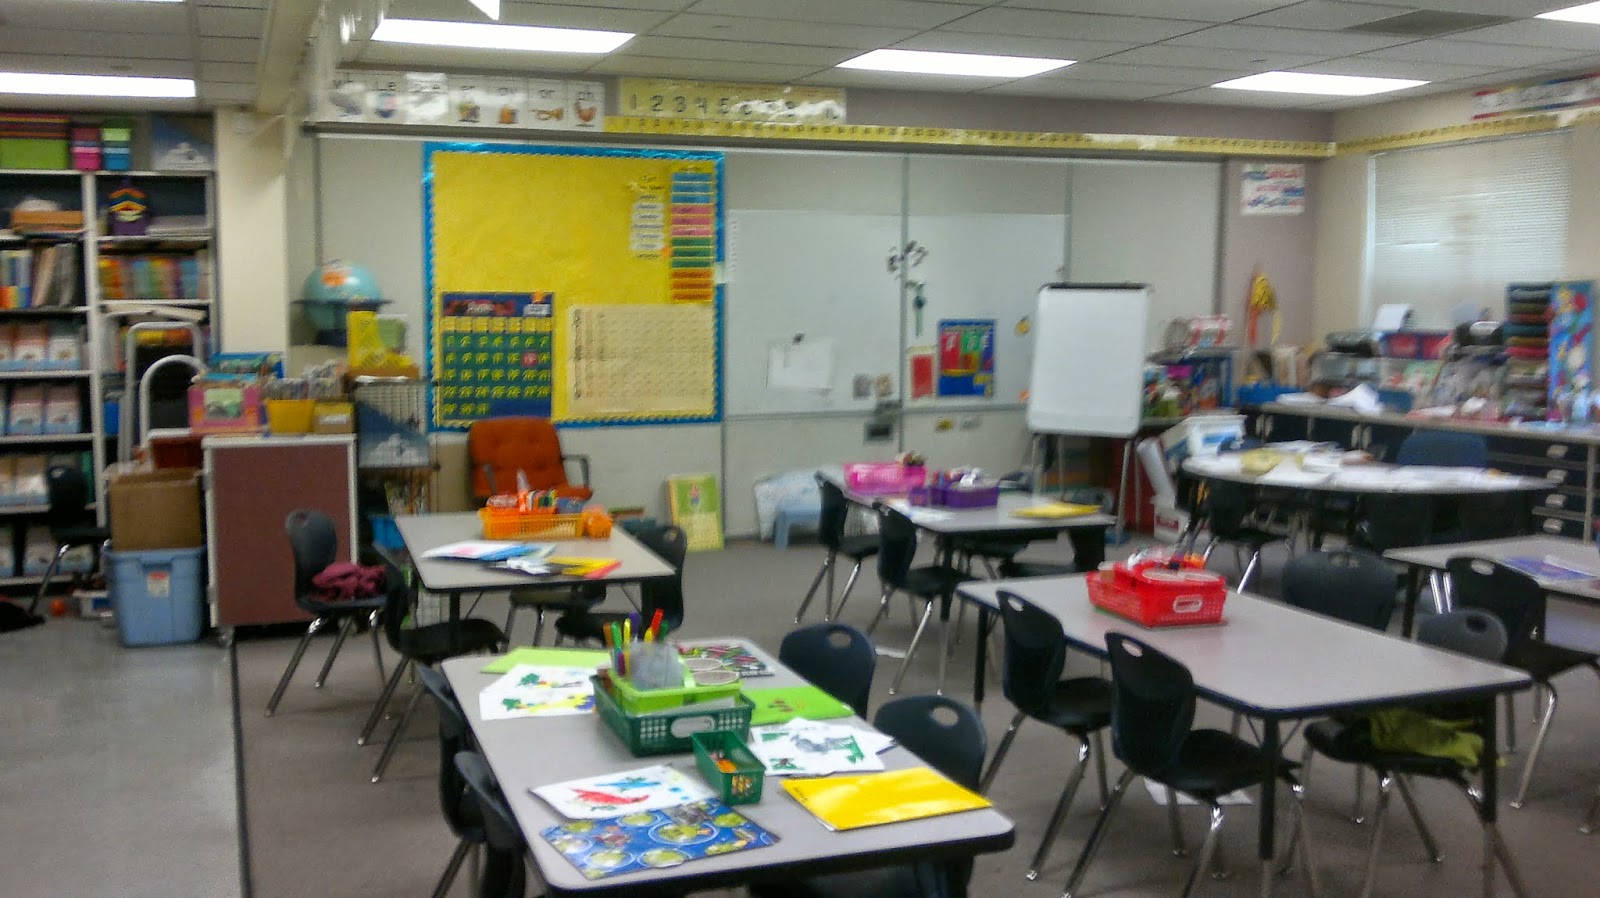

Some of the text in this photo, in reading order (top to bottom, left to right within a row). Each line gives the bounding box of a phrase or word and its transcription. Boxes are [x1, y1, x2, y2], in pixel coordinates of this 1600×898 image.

[630, 93, 638, 110] 1
[650, 94, 664, 112] 2
[673, 95, 688, 113] 3
[718, 97, 730, 115] 5
